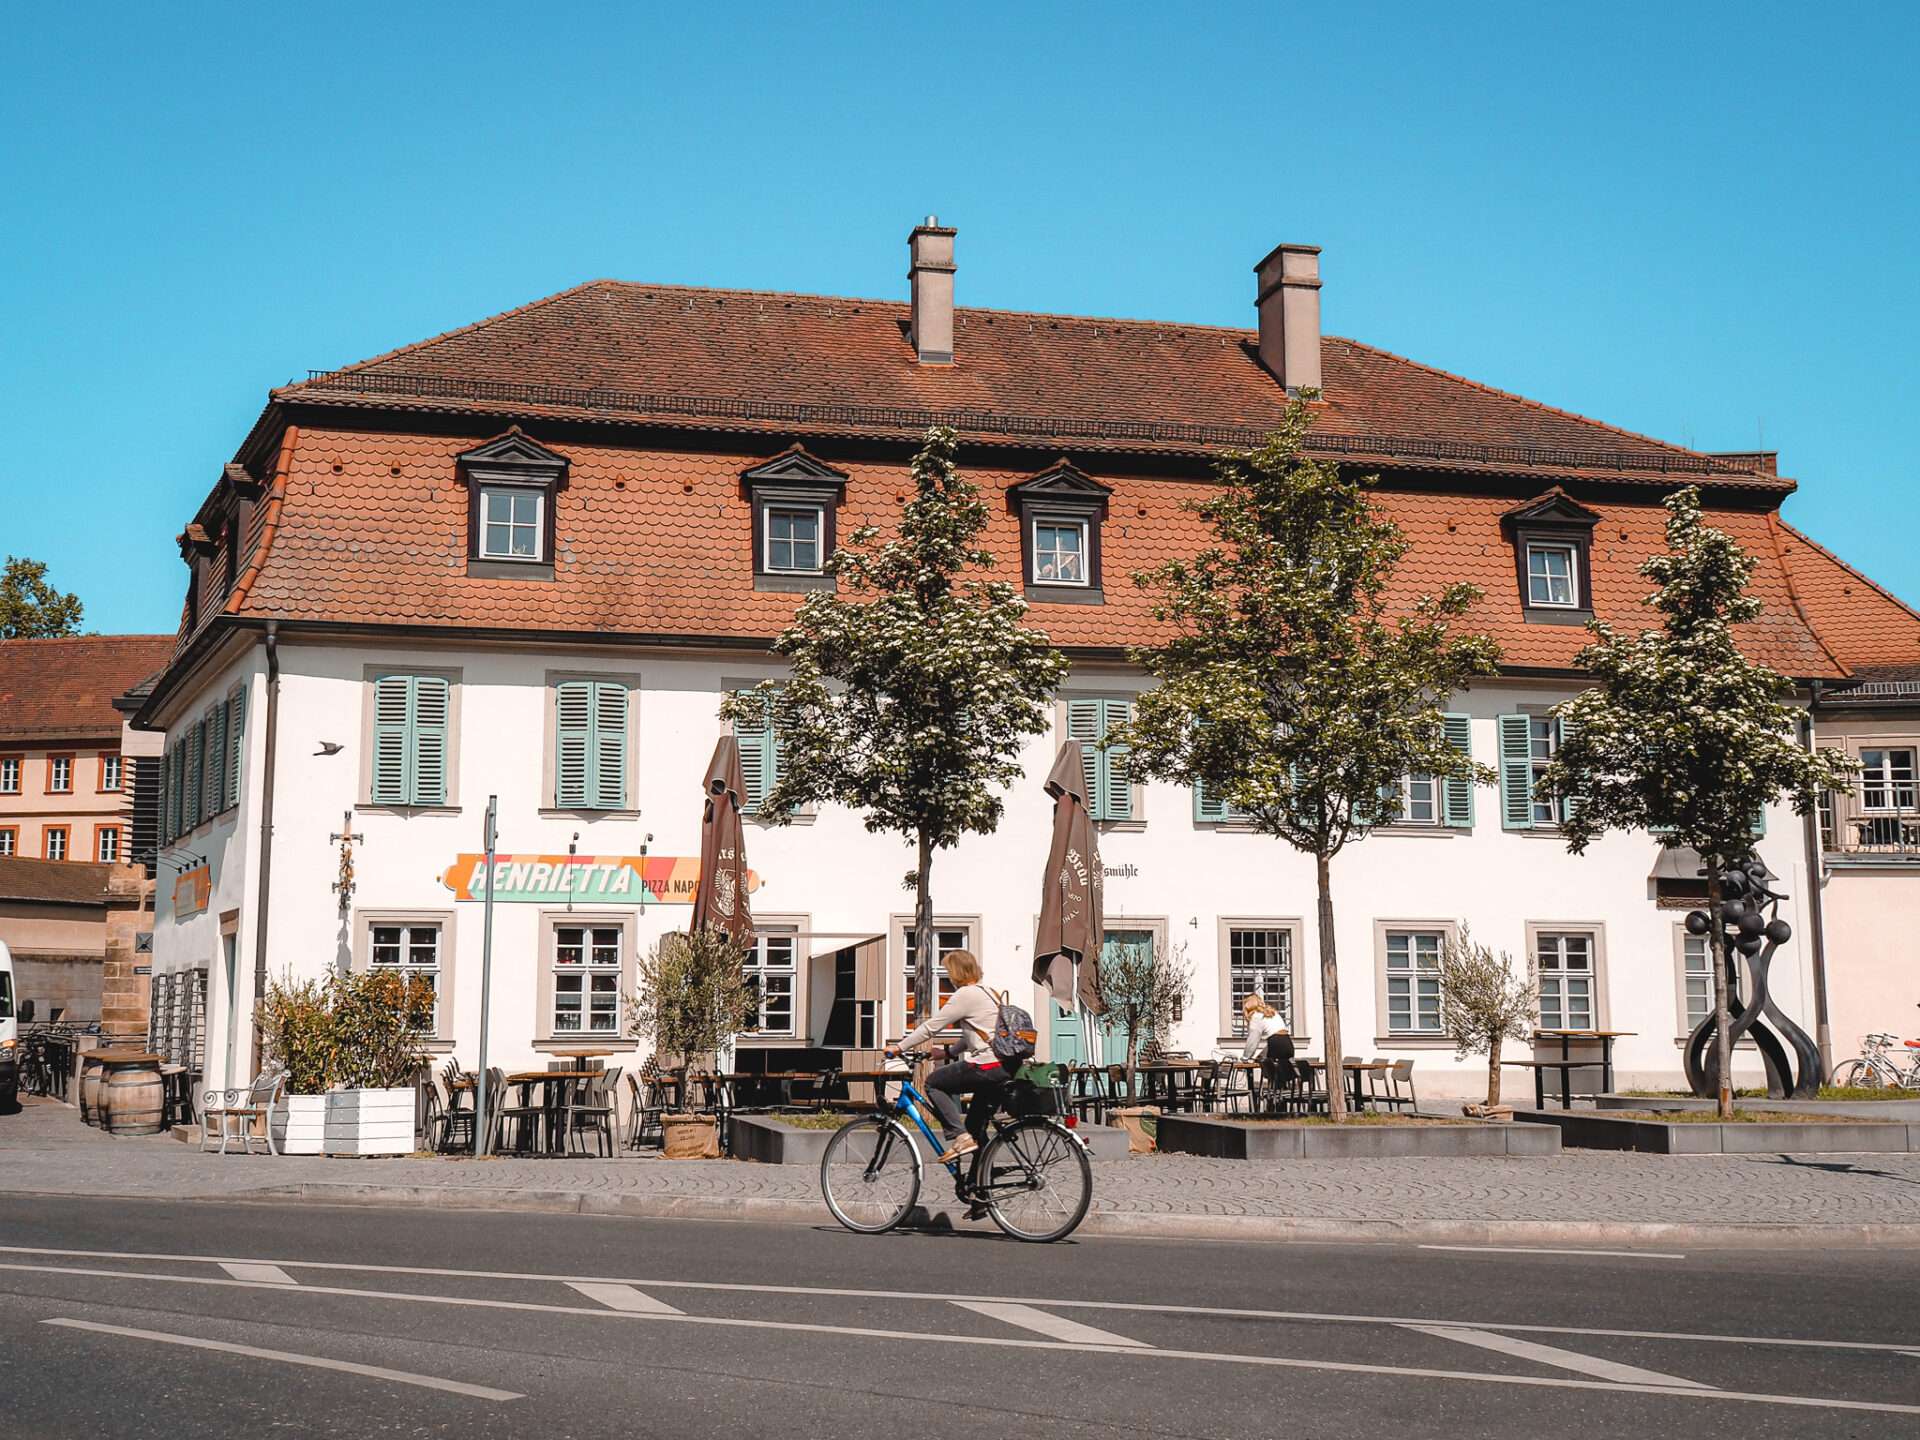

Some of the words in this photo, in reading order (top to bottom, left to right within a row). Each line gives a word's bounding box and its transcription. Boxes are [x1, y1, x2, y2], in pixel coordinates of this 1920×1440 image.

[467, 861, 634, 894] HENRIETTA
[1102, 864, 1139, 880] smühle
[642, 879, 670, 893] PIZZA
[1189, 916, 1198, 929] 4
